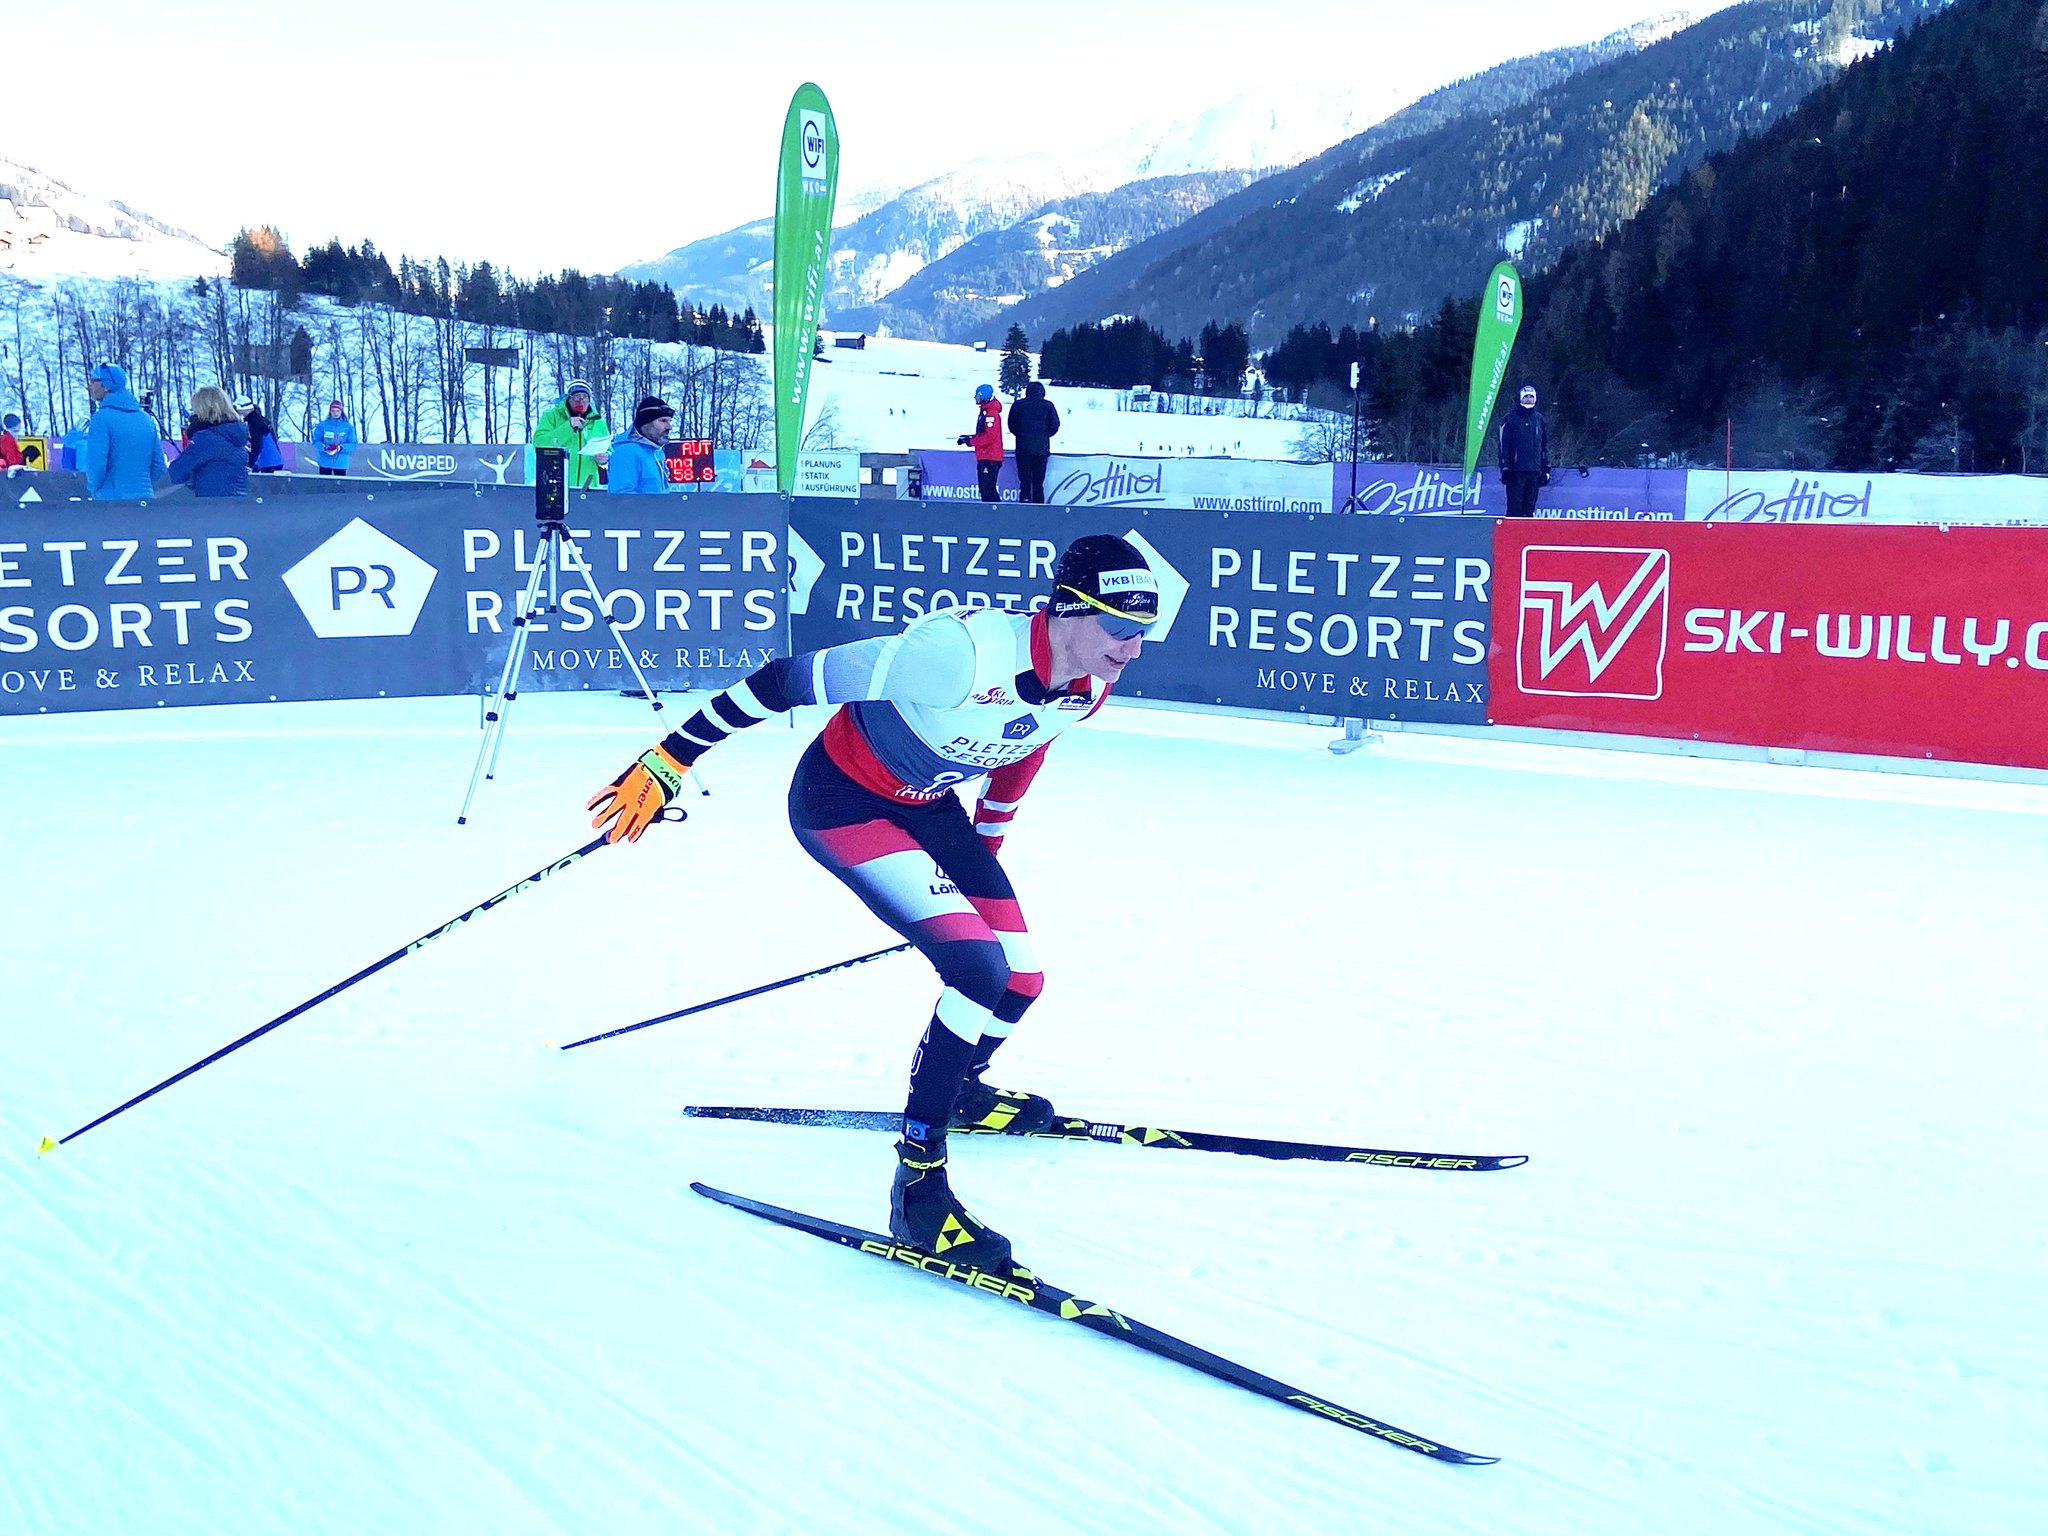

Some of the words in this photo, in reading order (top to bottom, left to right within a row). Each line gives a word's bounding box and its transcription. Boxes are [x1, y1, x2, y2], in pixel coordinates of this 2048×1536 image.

[807, 136, 824, 154] WIFI
[682, 441, 712, 455] AUT
[804, 460, 842, 469] PLANUNG
[804, 472, 830, 480] STATIK
[804, 483, 857, 493] AUSFÜHRUNG
[1193, 495, 1322, 513] www.osttirol.com
[463, 529, 778, 574] PLETZER
[840, 531, 1057, 580] PLETZER
[1102, 576, 1130, 586] VKB
[1211, 547, 1491, 603] PLETZER
[467, 588, 777, 634] RESORTS
[1208, 606, 1486, 665] RESORTS
[532, 648, 623, 673] MOVE
[676, 647, 776, 669] RELAX
[138, 660, 256, 687] RELAX
[1257, 668, 1336, 694] MOVE
[1349, 676, 1369, 697] &
[1384, 679, 1485, 704] RELAX
[1344, 1152, 1478, 1170] FISCHER
[860, 1240, 1035, 1305] FISCHER
[1287, 1394, 1439, 1453] FISCHER
